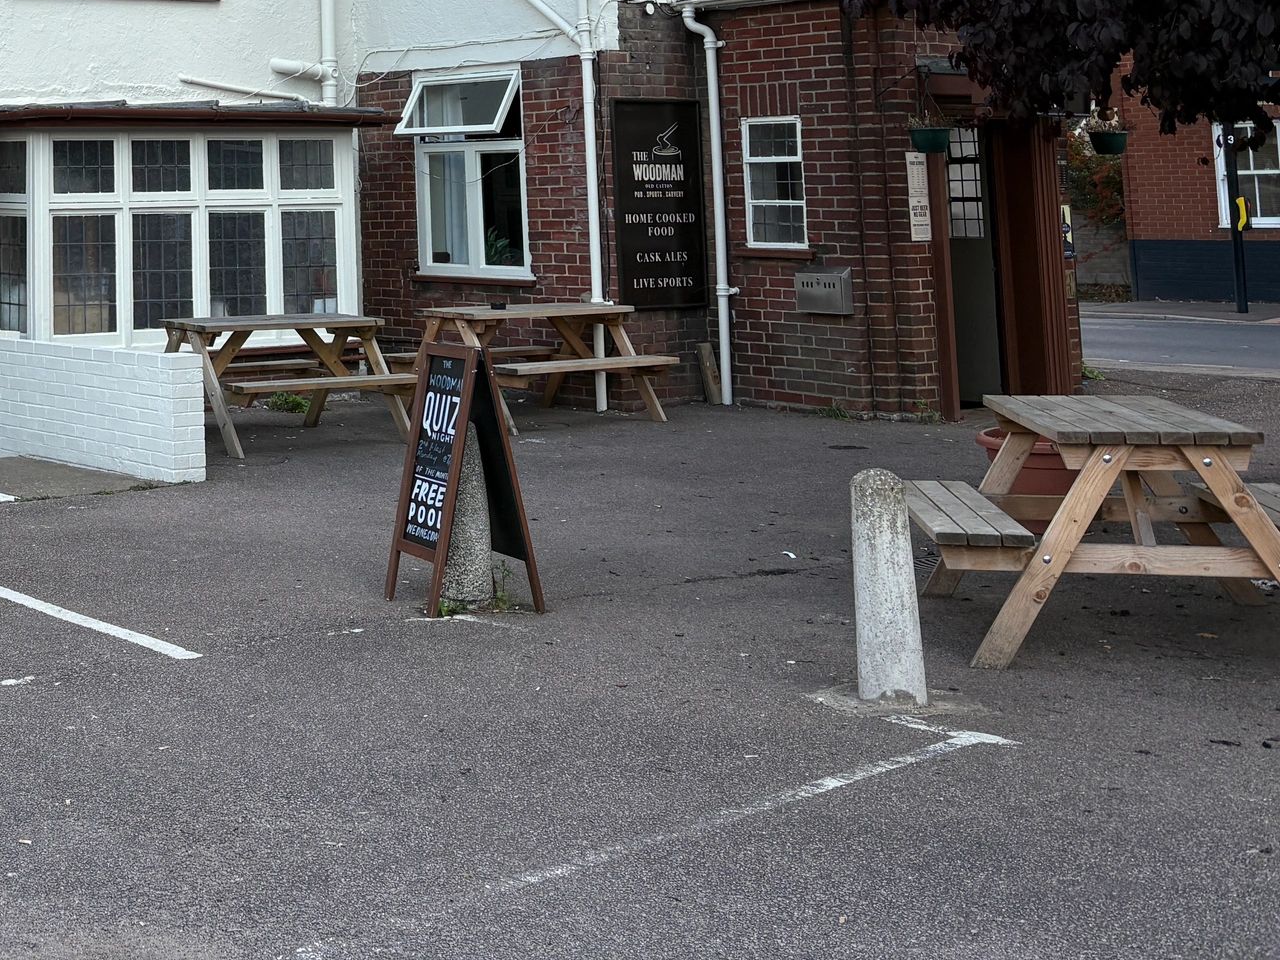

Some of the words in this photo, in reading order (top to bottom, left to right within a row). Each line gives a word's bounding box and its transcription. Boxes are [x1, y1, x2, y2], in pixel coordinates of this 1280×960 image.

[1227, 135, 1234, 145] 3
[632, 151, 648, 161] THE
[632, 163, 684, 181] WOODMAN
[625, 213, 654, 224] HOME
[656, 212, 695, 224] COOKED
[648, 226, 674, 237] FOOD
[636, 252, 661, 263] CASK
[664, 251, 688, 262] ALES
[633, 278, 656, 289] LIVE
[658, 276, 693, 288] SPORTS
[443, 360, 452, 369] THE
[423, 391, 460, 437] QUIZ
[431, 431, 454, 444] NIGHT
[424, 467, 435, 477] THE
[411, 479, 447, 507] FREE
[406, 523, 440, 543] WEDNESDA
